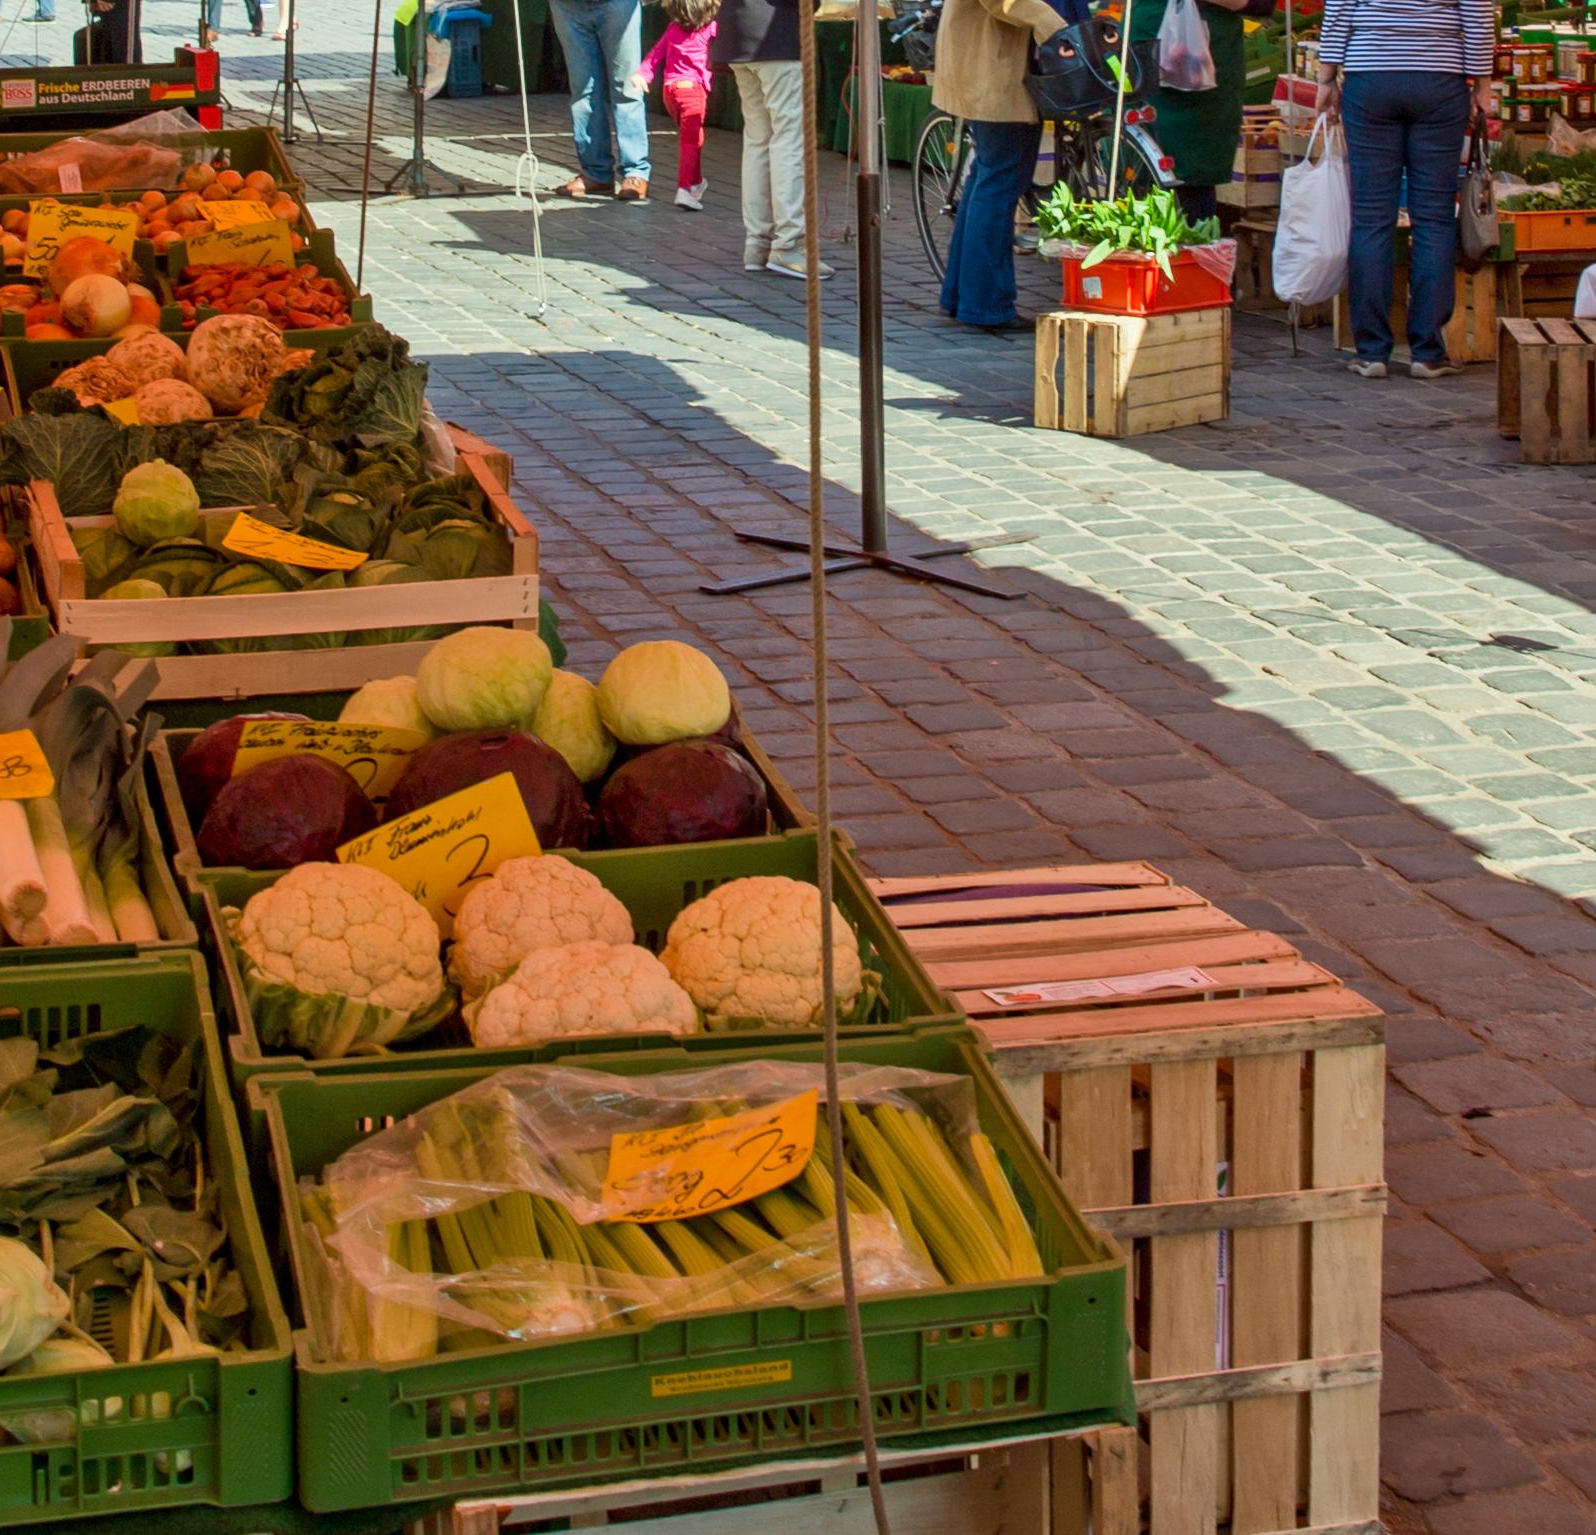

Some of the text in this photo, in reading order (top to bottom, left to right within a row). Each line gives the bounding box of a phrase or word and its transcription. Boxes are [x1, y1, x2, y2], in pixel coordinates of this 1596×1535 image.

[38, 78, 151, 94] Frische ERDBEEREN
[38, 90, 134, 105] aus Deutschland
